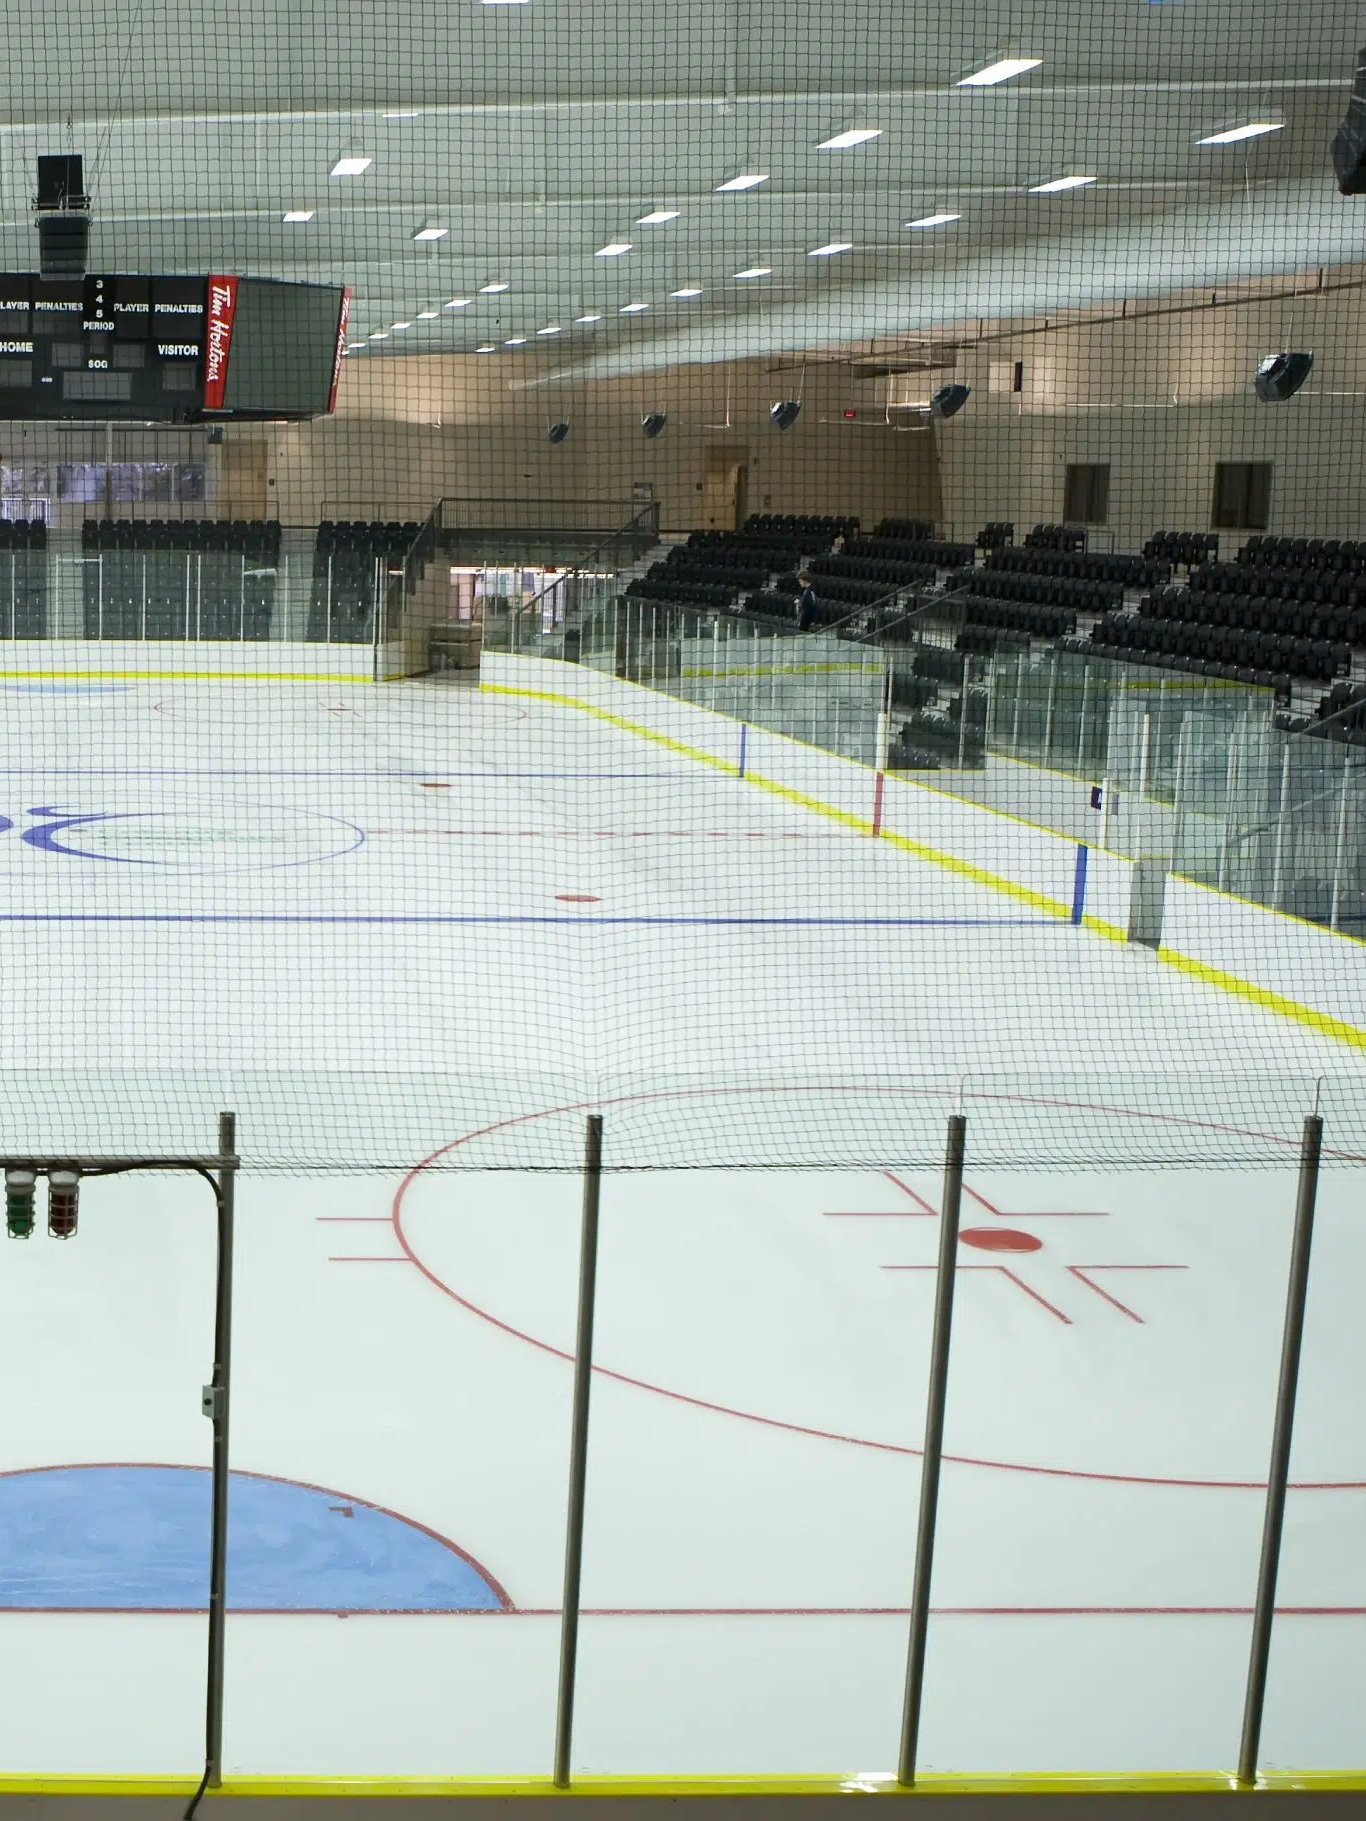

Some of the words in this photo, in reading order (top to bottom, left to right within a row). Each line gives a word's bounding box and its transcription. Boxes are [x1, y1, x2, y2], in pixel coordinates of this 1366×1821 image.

[96, 280, 104, 289] 3
[95, 295, 104, 304] 4
[211, 285, 231, 317] Tim
[34, 302, 84, 311] PENALTIES
[114, 303, 150, 312] PLAYER
[154, 304, 204, 314] PENALTIES
[95, 309, 104, 318] 5
[83, 321, 115, 331] PERIOD
[157, 344, 199, 356] VISITOR
[207, 319, 229, 381] Hortons
[88, 359, 108, 369] SOG
